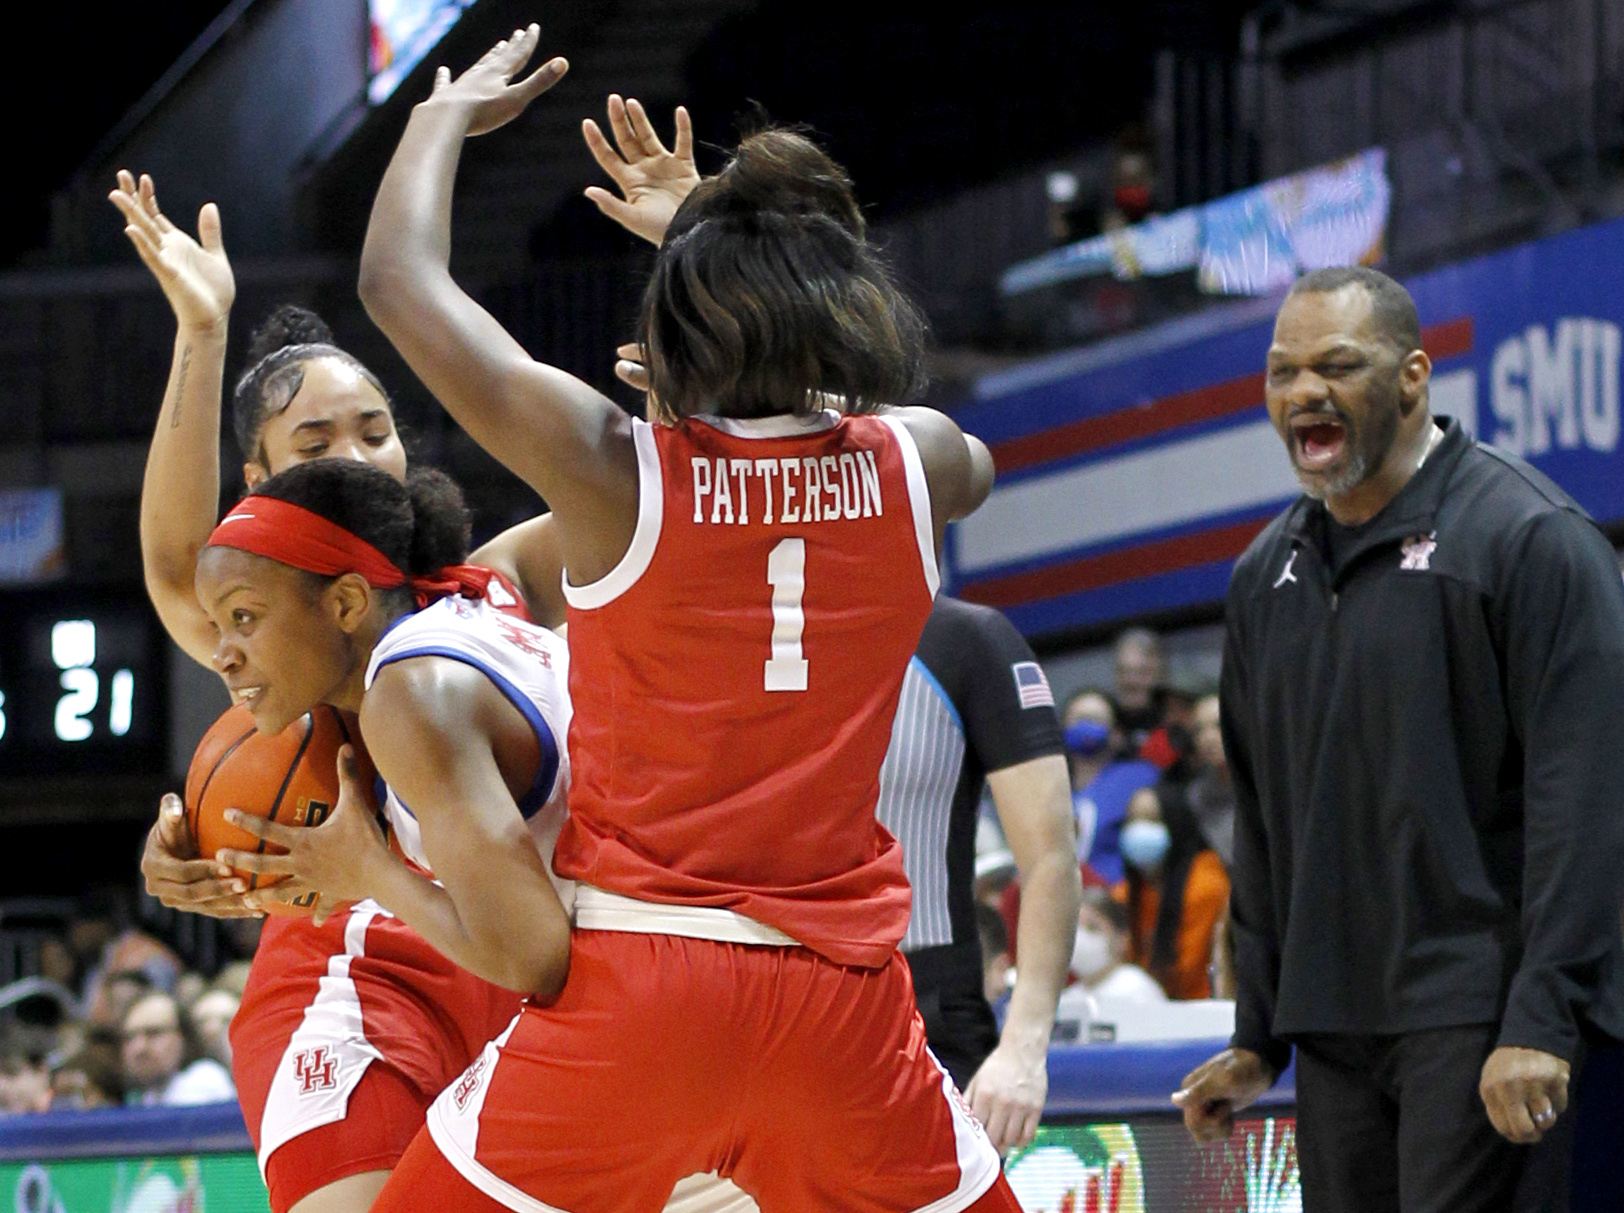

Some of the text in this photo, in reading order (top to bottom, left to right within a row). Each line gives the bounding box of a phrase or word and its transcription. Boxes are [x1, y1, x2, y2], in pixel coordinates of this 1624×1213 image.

[1489, 317, 1621, 459] SMU
[691, 450, 882, 525] PATTERSON
[764, 537, 808, 691] 1
[54, 667, 134, 742] 21
[293, 1046, 337, 1094] UH
